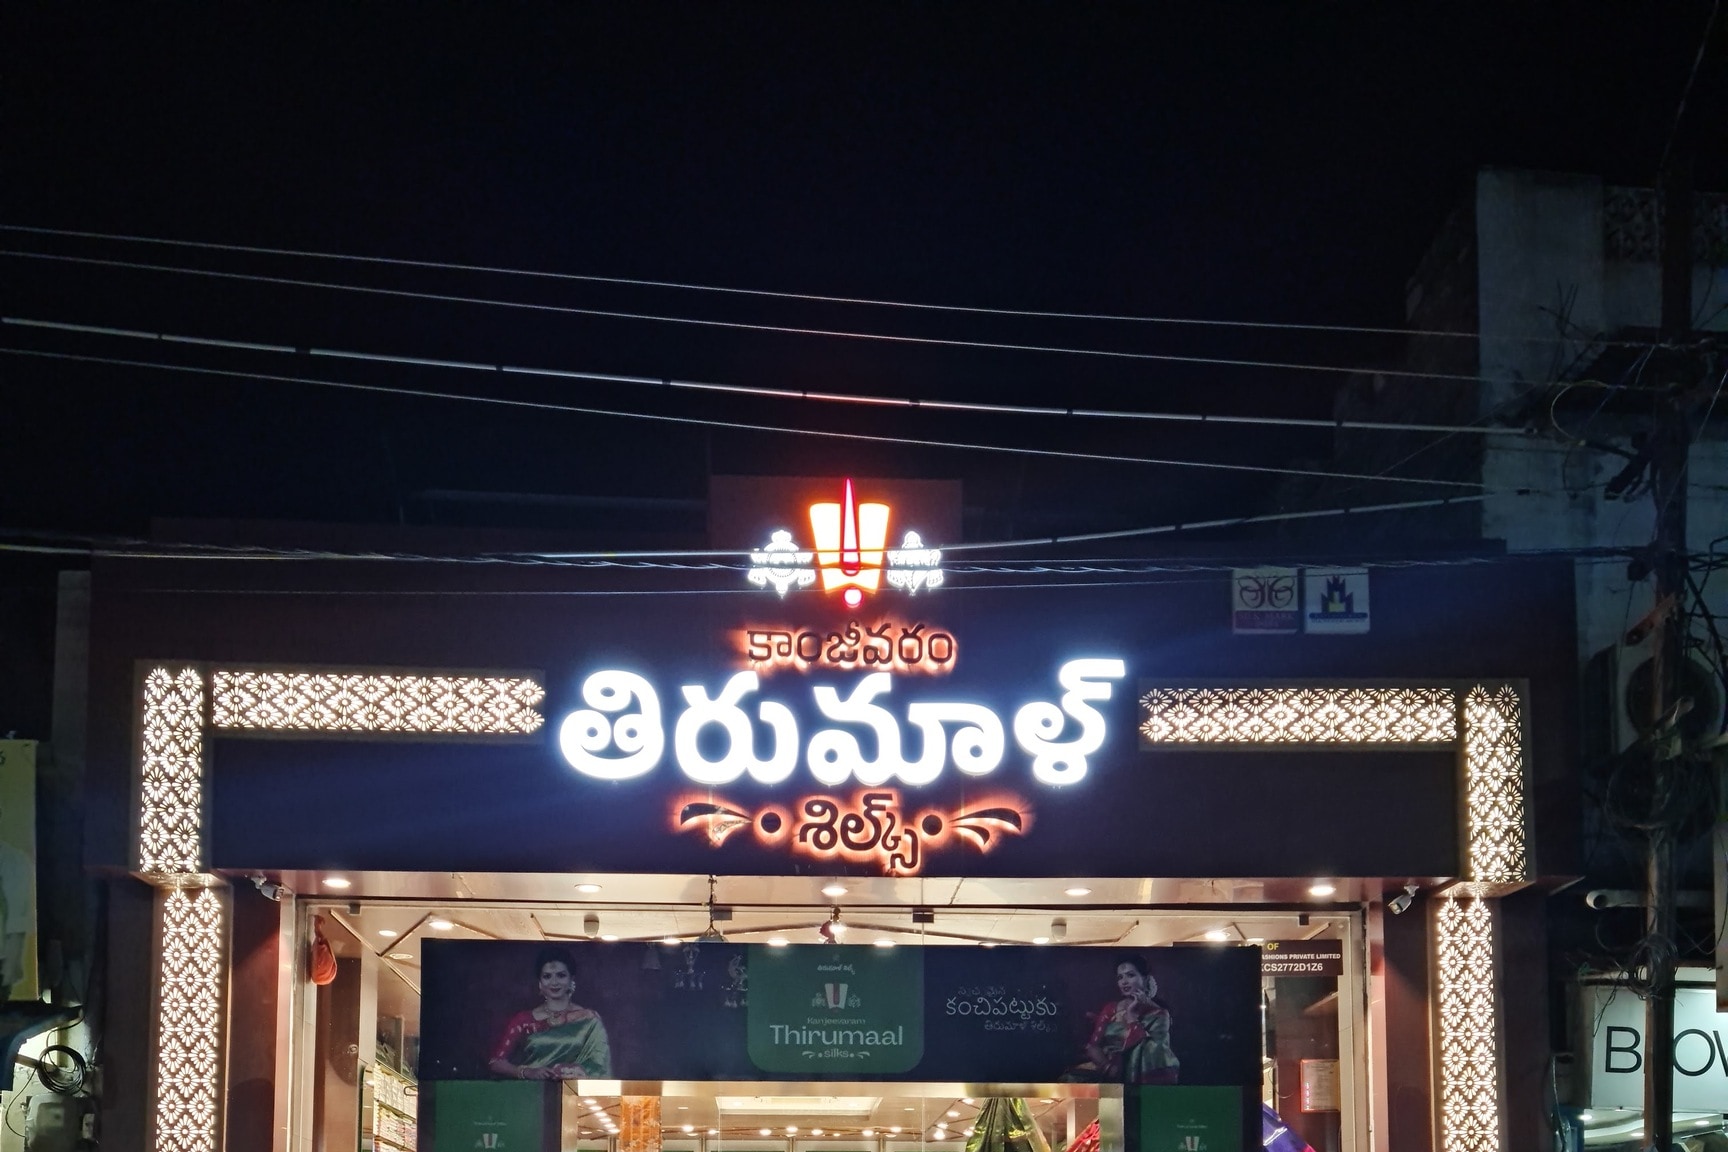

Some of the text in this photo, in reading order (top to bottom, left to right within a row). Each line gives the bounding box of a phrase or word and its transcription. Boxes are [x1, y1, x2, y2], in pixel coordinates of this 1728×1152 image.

[747, 622, 954, 666] కాంజీవరం
[557, 657, 1127, 787] తిరుమాళ్
[1267, 942, 1280, 951] OF
[945, 996, 1057, 1020] కంచిపట్టుకు
[807, 1017, 866, 1027] Kanjeevaram
[769, 1025, 904, 1046] Thirumaal
[824, 1048, 849, 1058] silks
[1605, 1026, 1728, 1077] BO
